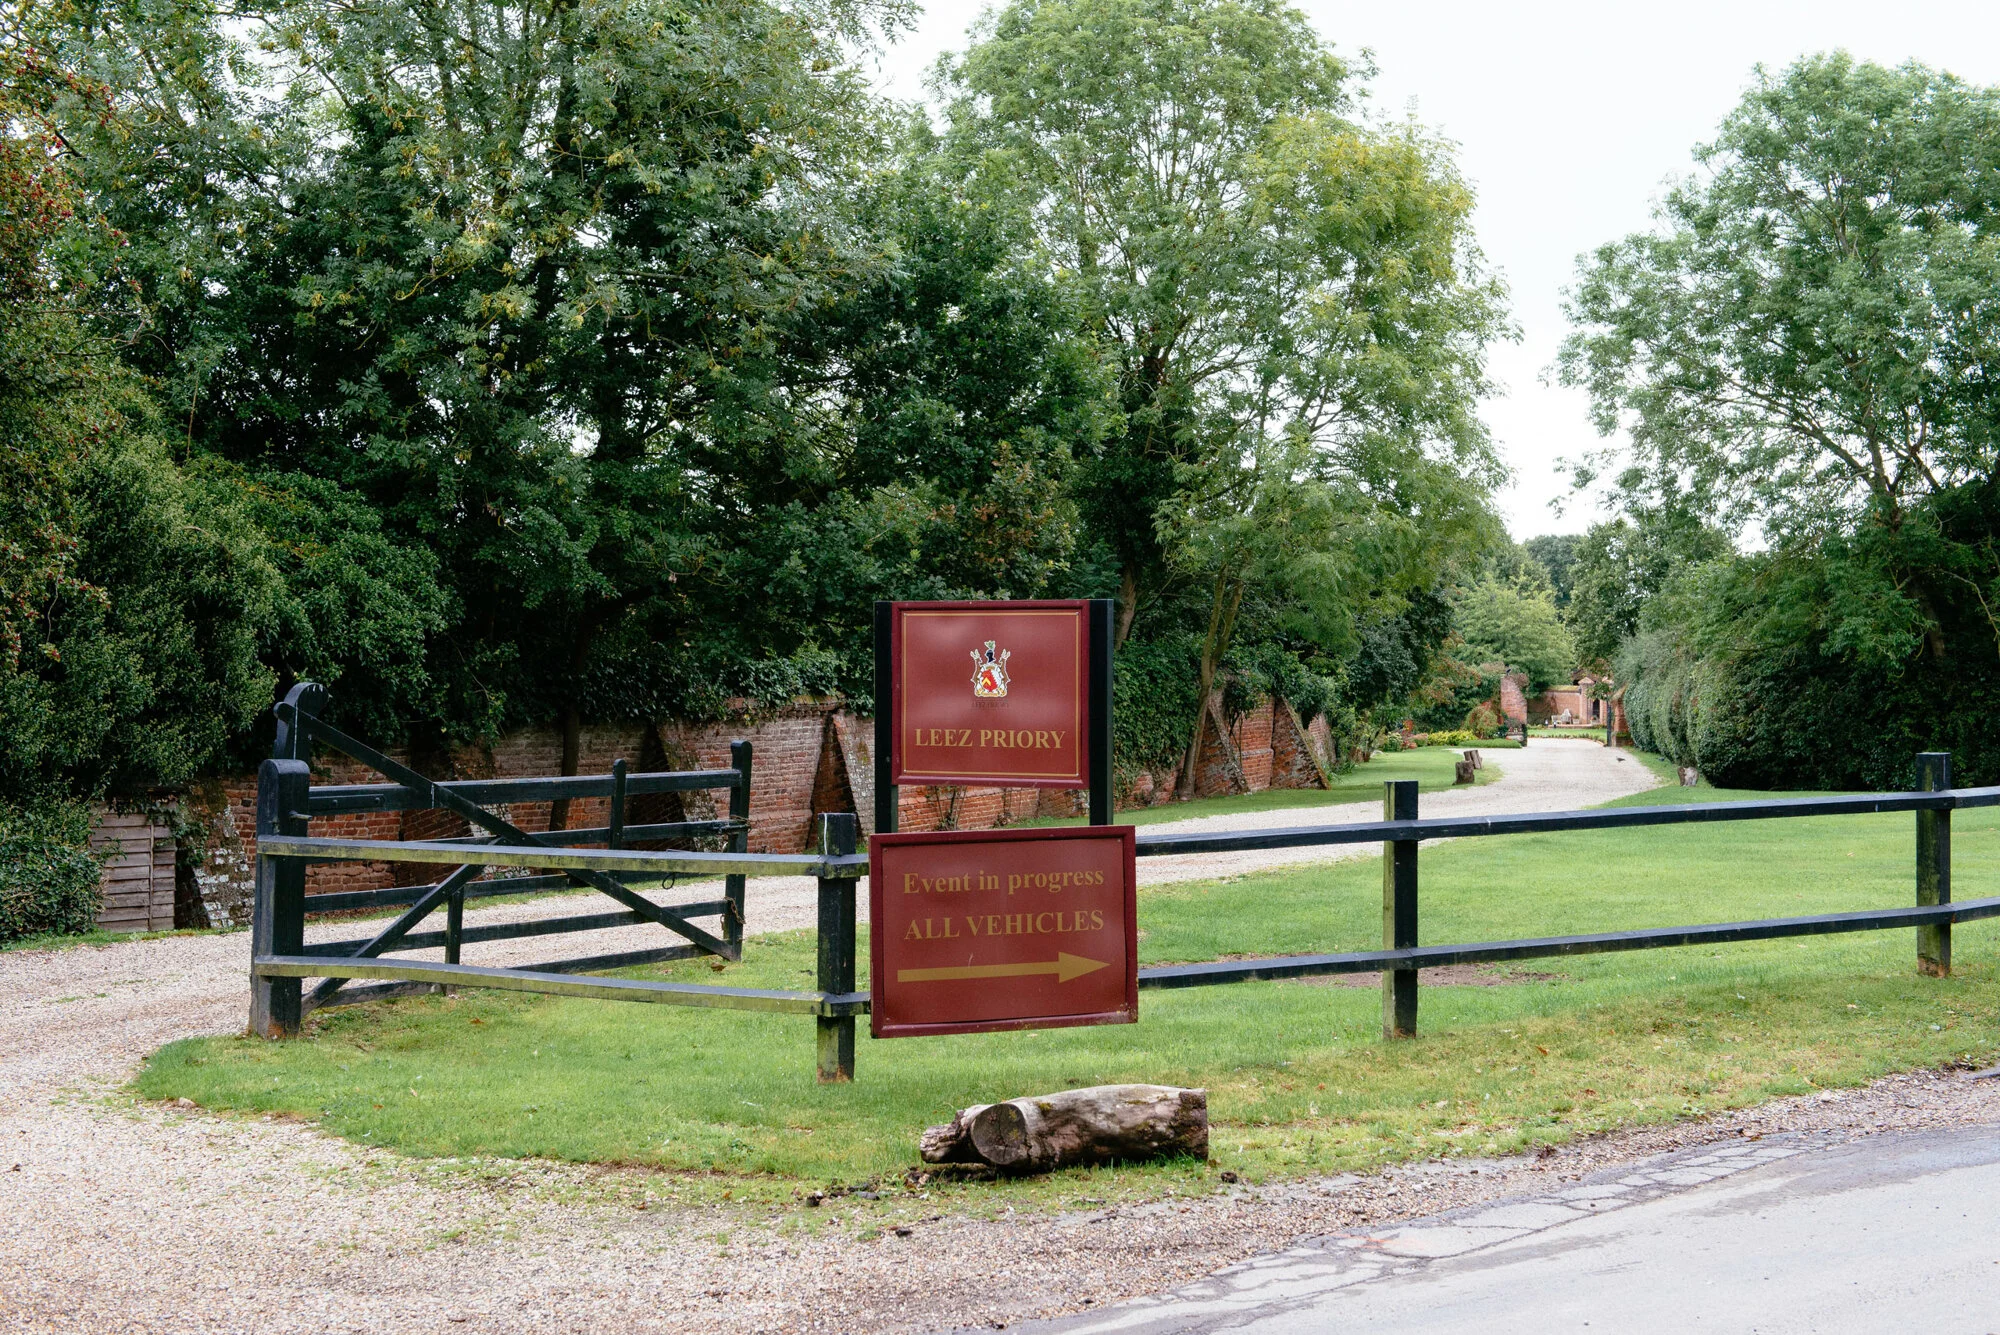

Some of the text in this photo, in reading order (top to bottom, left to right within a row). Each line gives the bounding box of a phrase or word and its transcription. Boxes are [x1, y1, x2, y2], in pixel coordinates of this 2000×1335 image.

[915, 728, 1066, 749] LEEZ PRIORY
[903, 869, 1104, 895] Event in progress
[904, 910, 1104, 940] ALL VEHICLES
